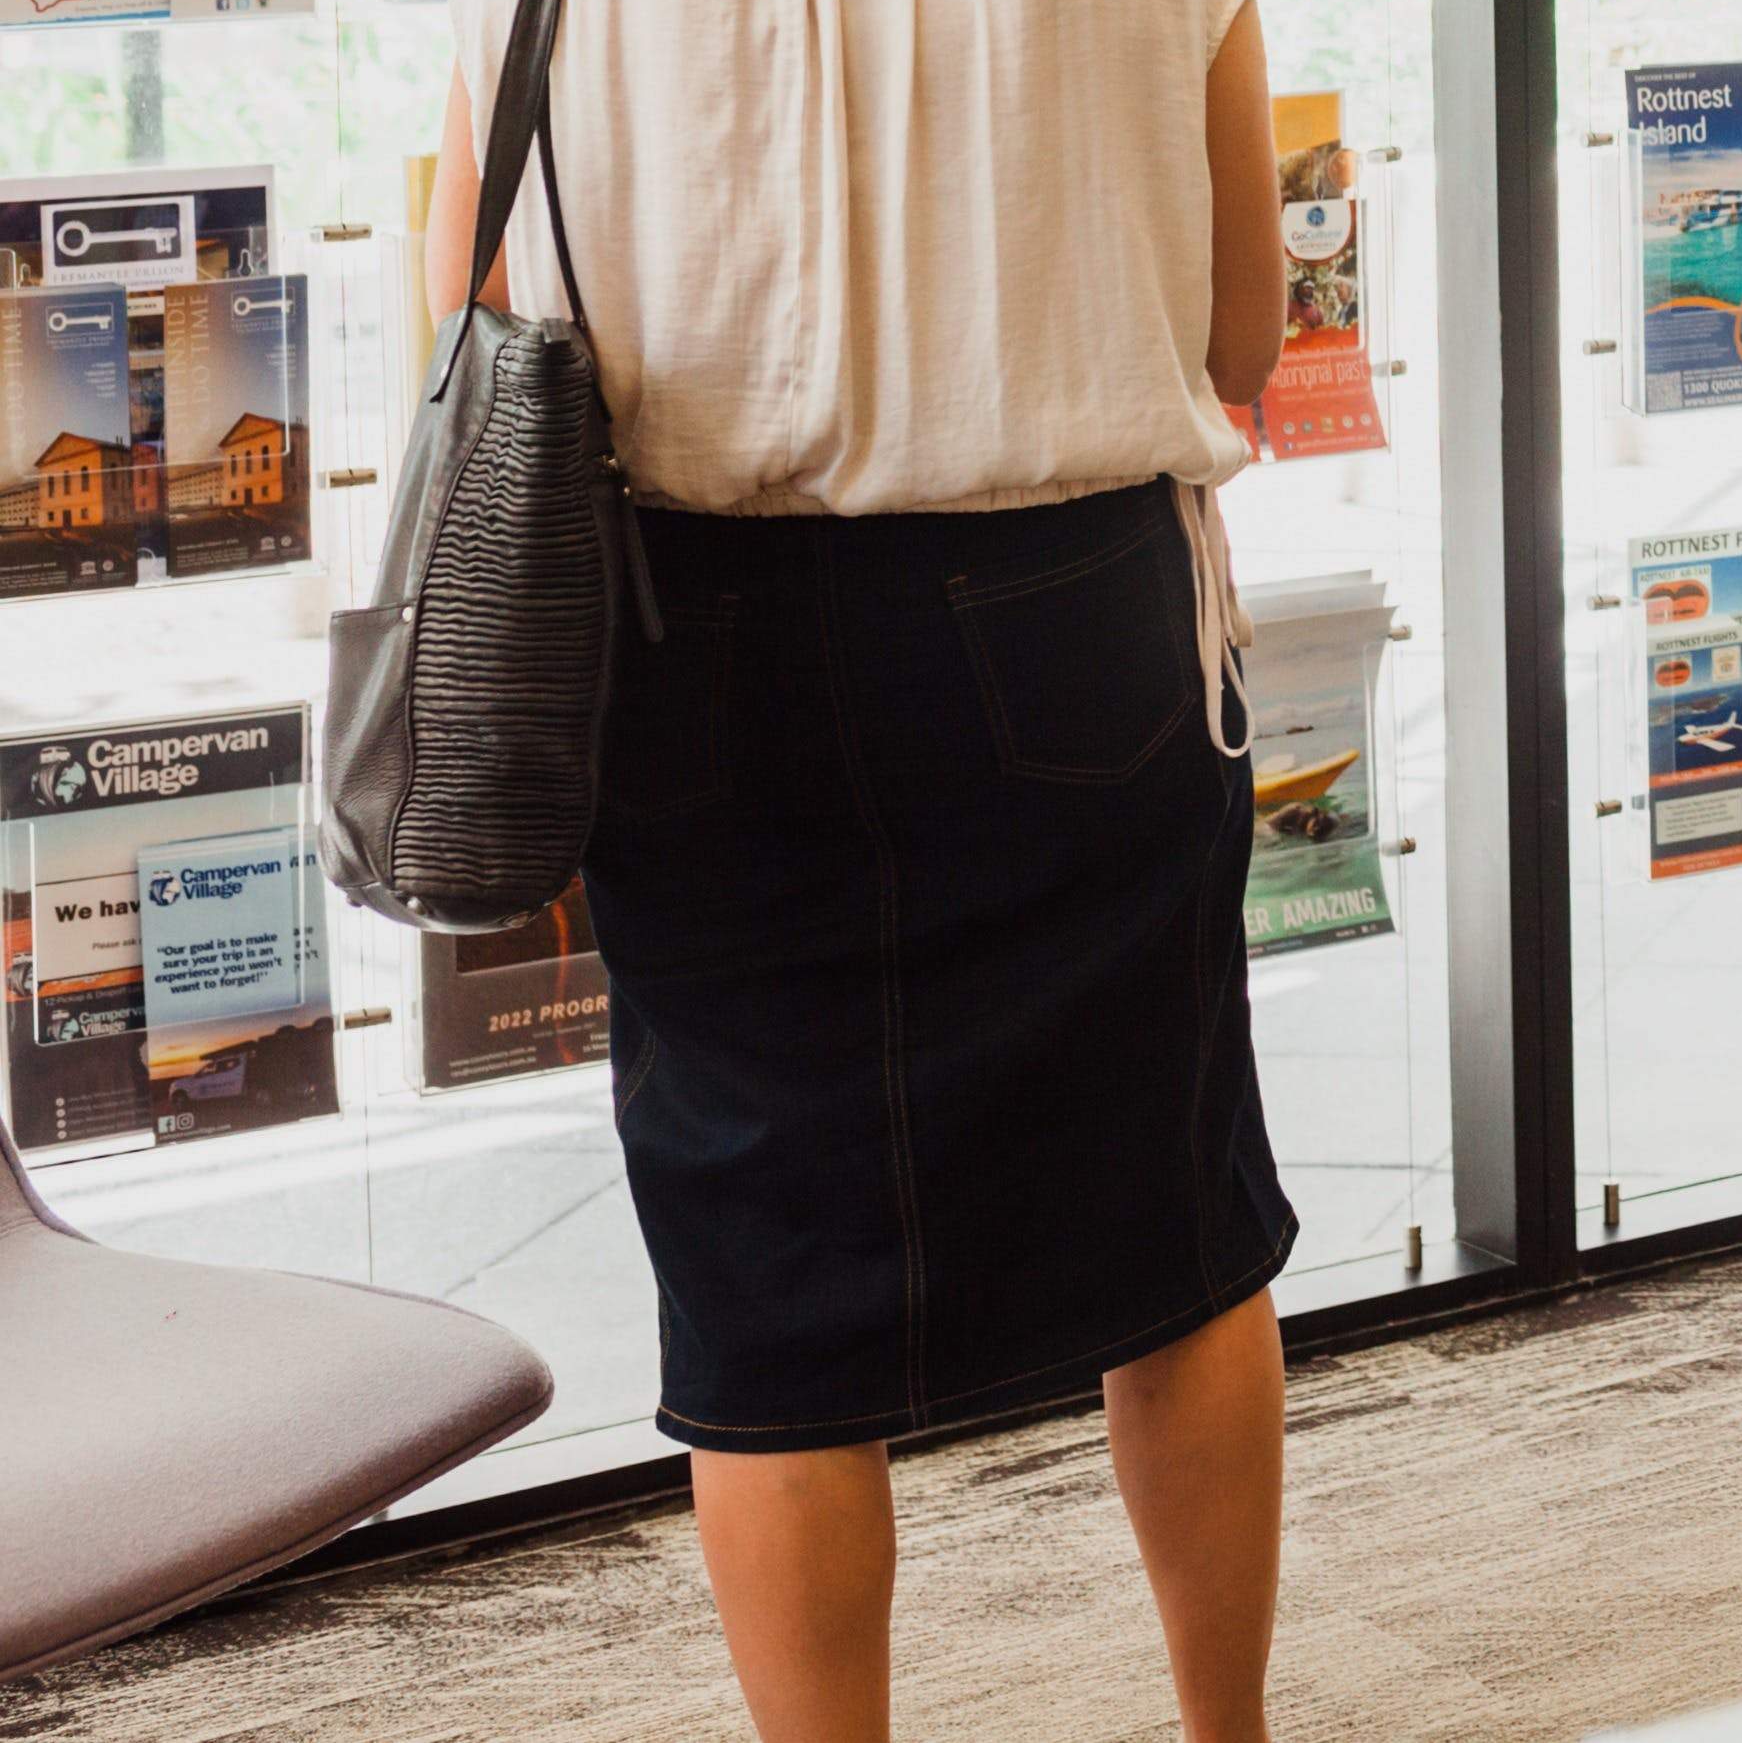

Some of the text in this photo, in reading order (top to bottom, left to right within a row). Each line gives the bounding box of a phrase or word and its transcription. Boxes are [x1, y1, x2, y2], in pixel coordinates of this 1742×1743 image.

[1637, 84, 1732, 113] Rottnest
[1639, 115, 1707, 145] Island
[1642, 534, 1728, 559] ROTTNEST
[1656, 632, 1738, 651] ROTTNEST FLIGHTS
[88, 726, 269, 769] Campervan
[90, 762, 199, 797] Village
[181, 859, 281, 884] Campervan
[183, 881, 243, 901] Village
[55, 903, 91, 923] We
[1283, 887, 1376, 928] AMAZING
[189, 939, 214, 955] goal
[217, 938, 227, 949] is
[229, 938, 242, 949] to
[245, 932, 278, 946] make
[162, 947, 274, 969] sure your trip is an
[154, 966, 220, 984] experience
[222, 963, 246, 977] you
[170, 980, 202, 995] want
[203, 979, 217, 991] to
[489, 1009, 533, 1033] 2022
